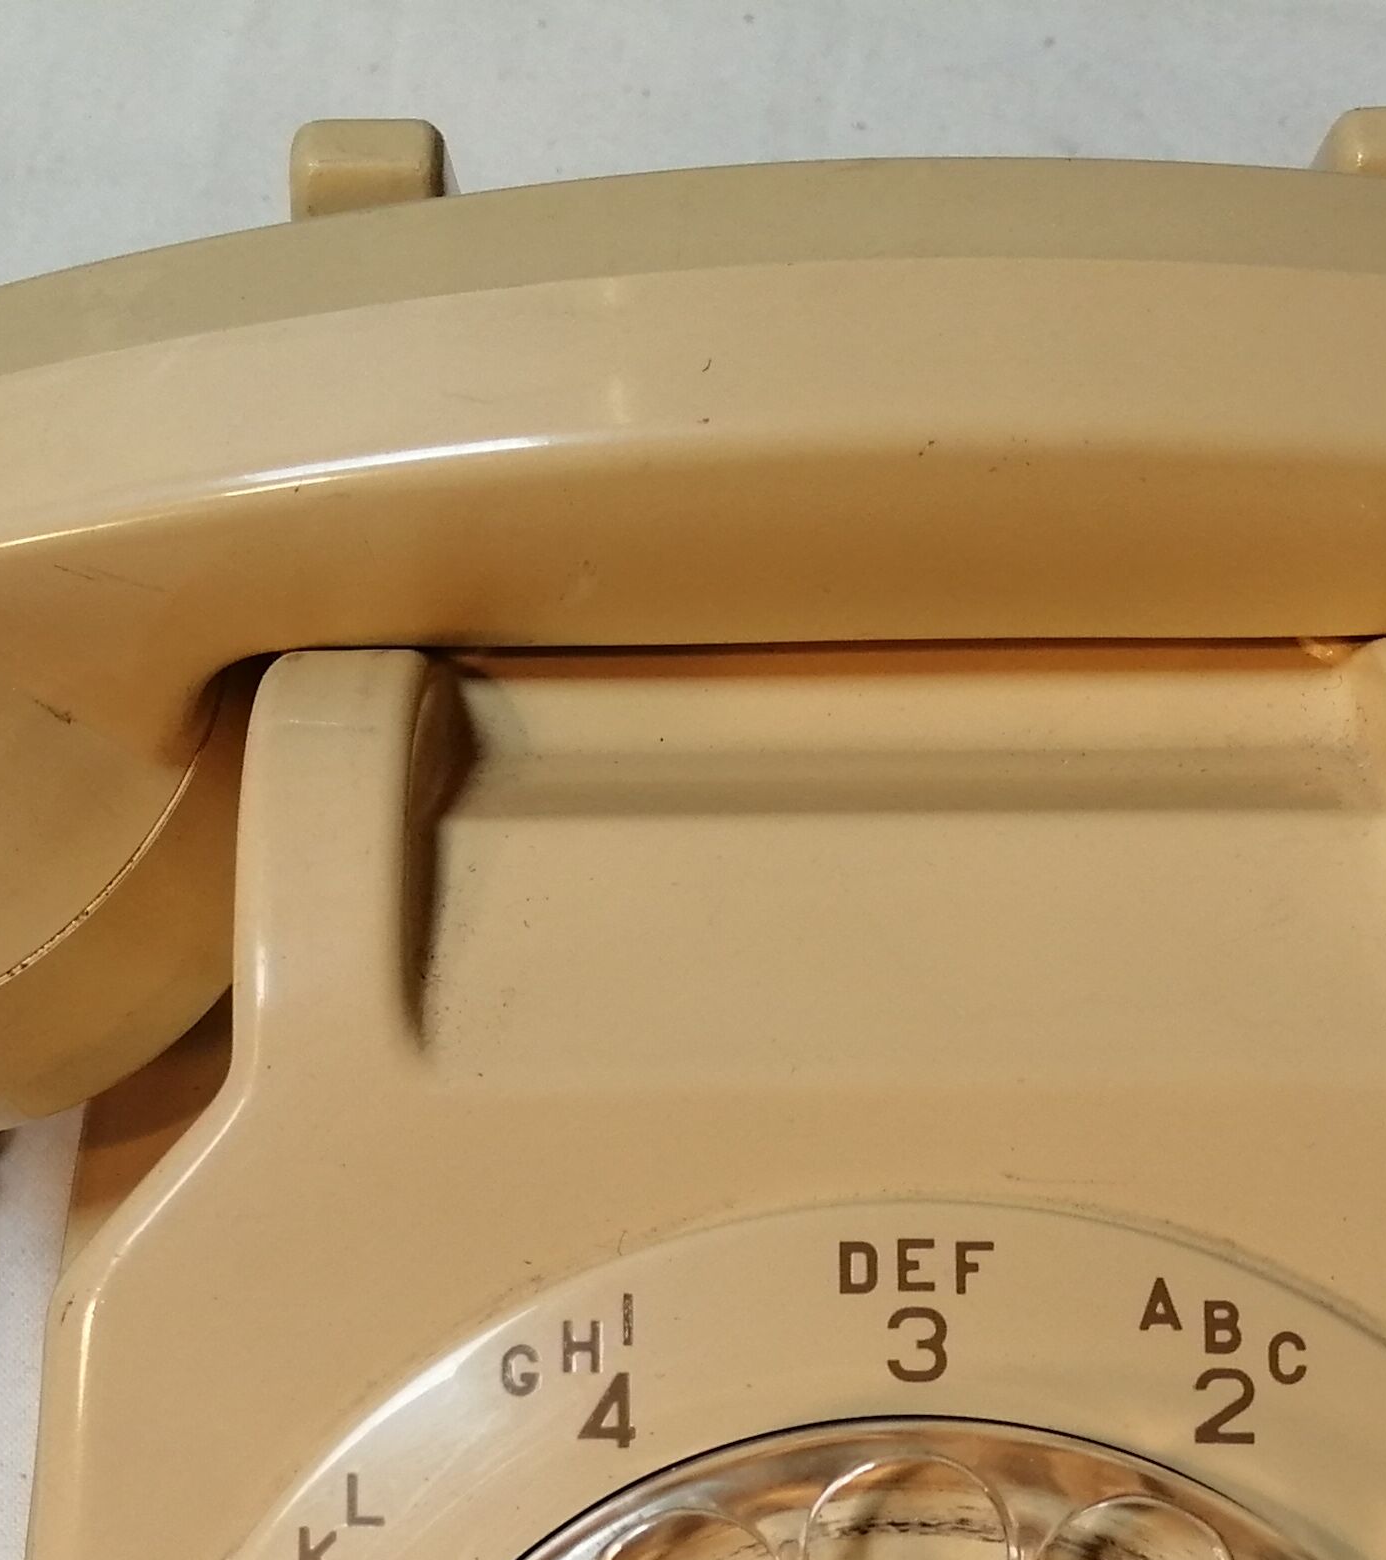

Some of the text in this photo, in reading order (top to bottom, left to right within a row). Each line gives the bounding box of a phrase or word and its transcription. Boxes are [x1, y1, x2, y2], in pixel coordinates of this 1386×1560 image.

[886, 1306, 949, 1383] 3
[577, 1372, 636, 1449] 4
[1194, 1367, 1256, 1445] 2
